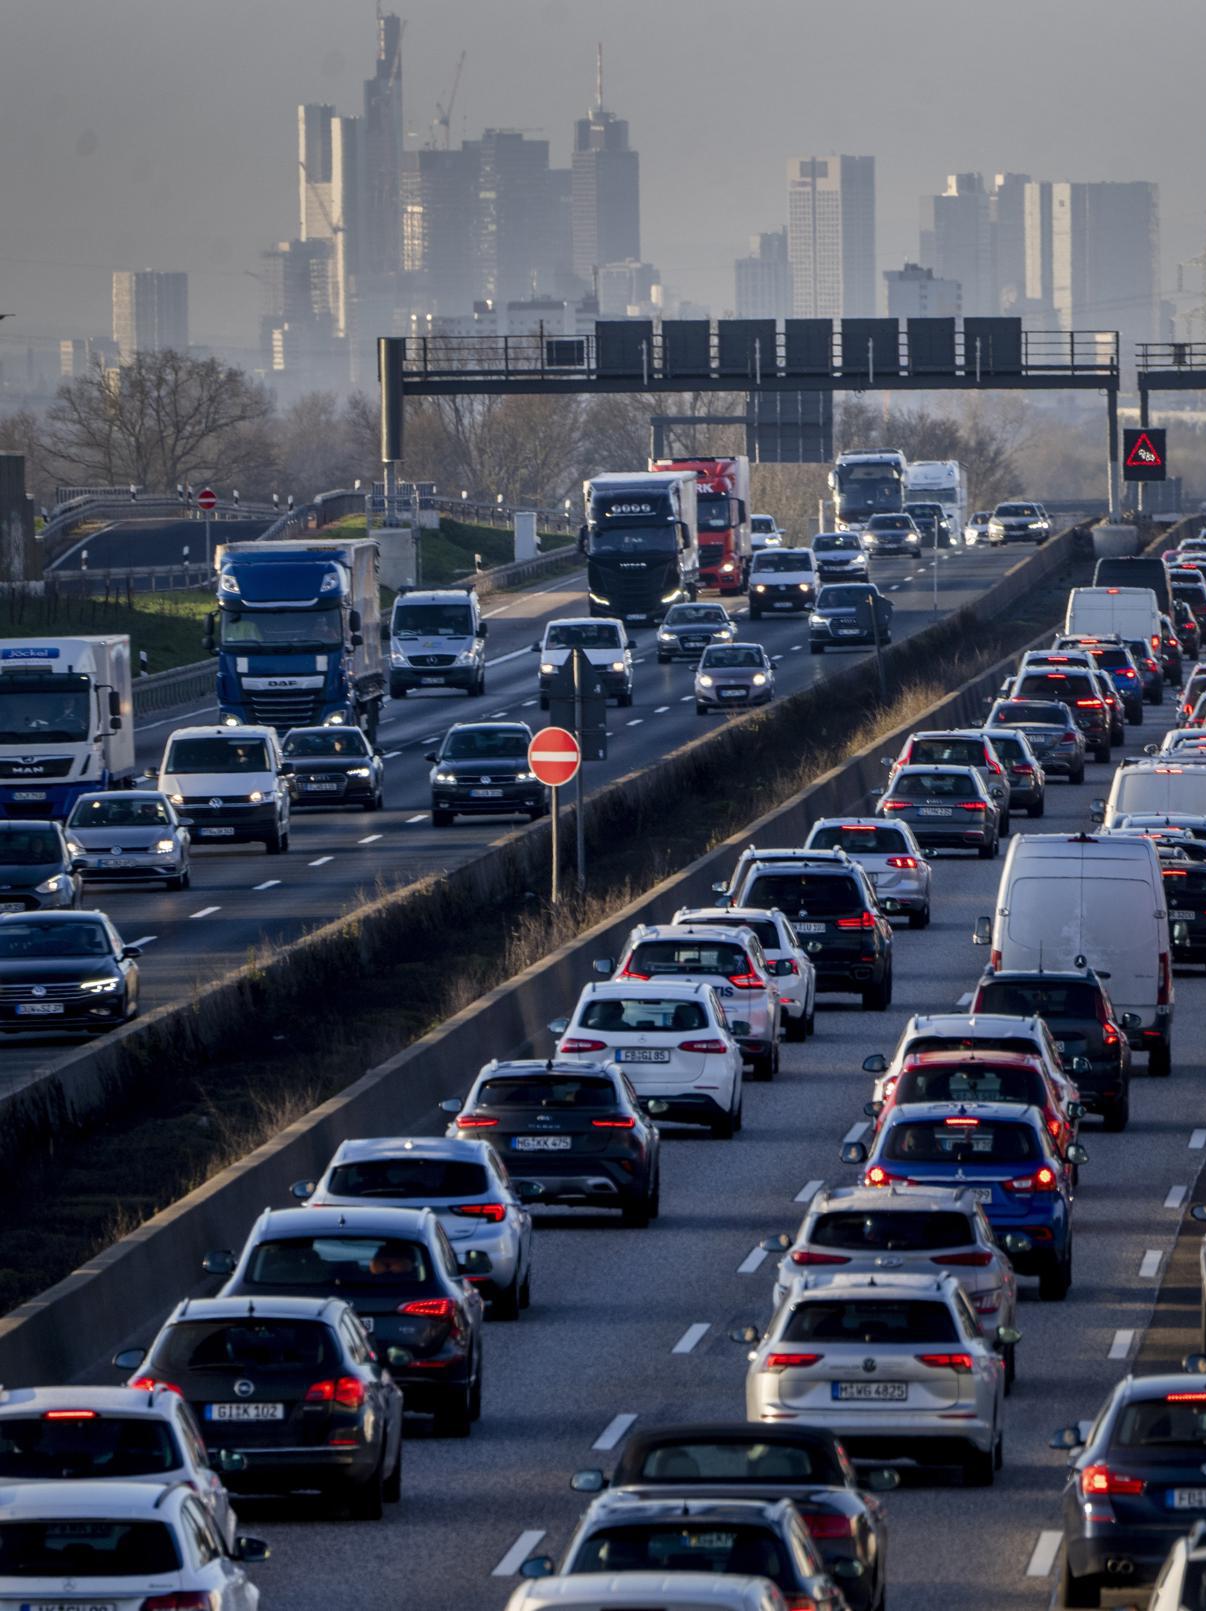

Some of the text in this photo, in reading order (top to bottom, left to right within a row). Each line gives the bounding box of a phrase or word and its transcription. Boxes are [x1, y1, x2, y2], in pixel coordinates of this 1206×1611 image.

[9, 649, 48, 658] Jöckel
[217, 1406, 236, 1418] GI
[254, 1405, 277, 1417] 102
